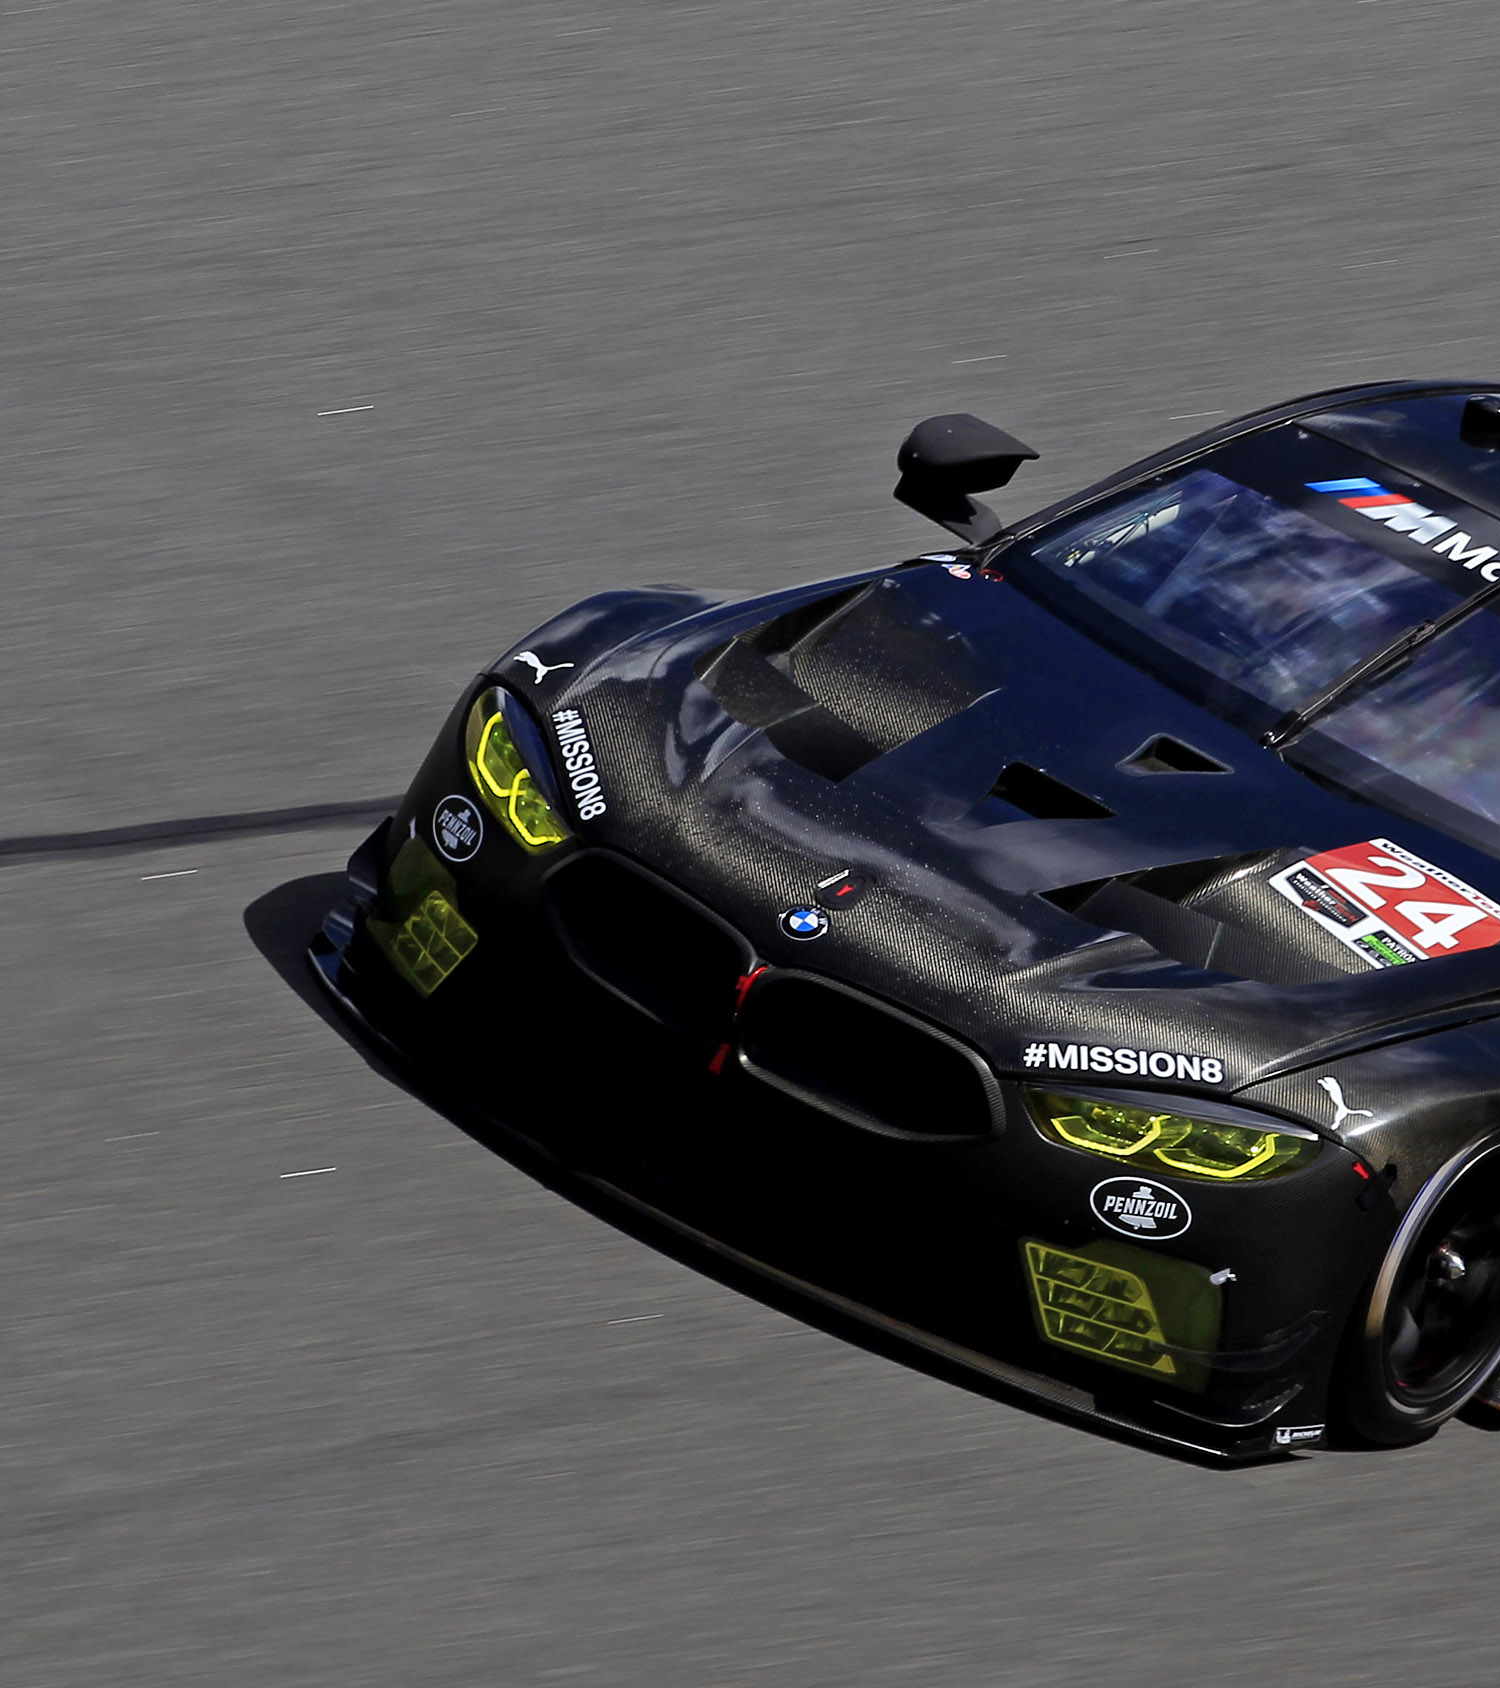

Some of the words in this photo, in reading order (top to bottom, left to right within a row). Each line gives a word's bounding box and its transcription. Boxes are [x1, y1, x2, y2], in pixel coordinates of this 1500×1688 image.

[552, 708, 607, 822] #MISSION8
[437, 809, 477, 846] PENNZOIL
[1324, 856, 1490, 950] 24
[1022, 1043, 1225, 1084] #MISSION8
[1103, 1195, 1178, 1221] PENNZOIL
